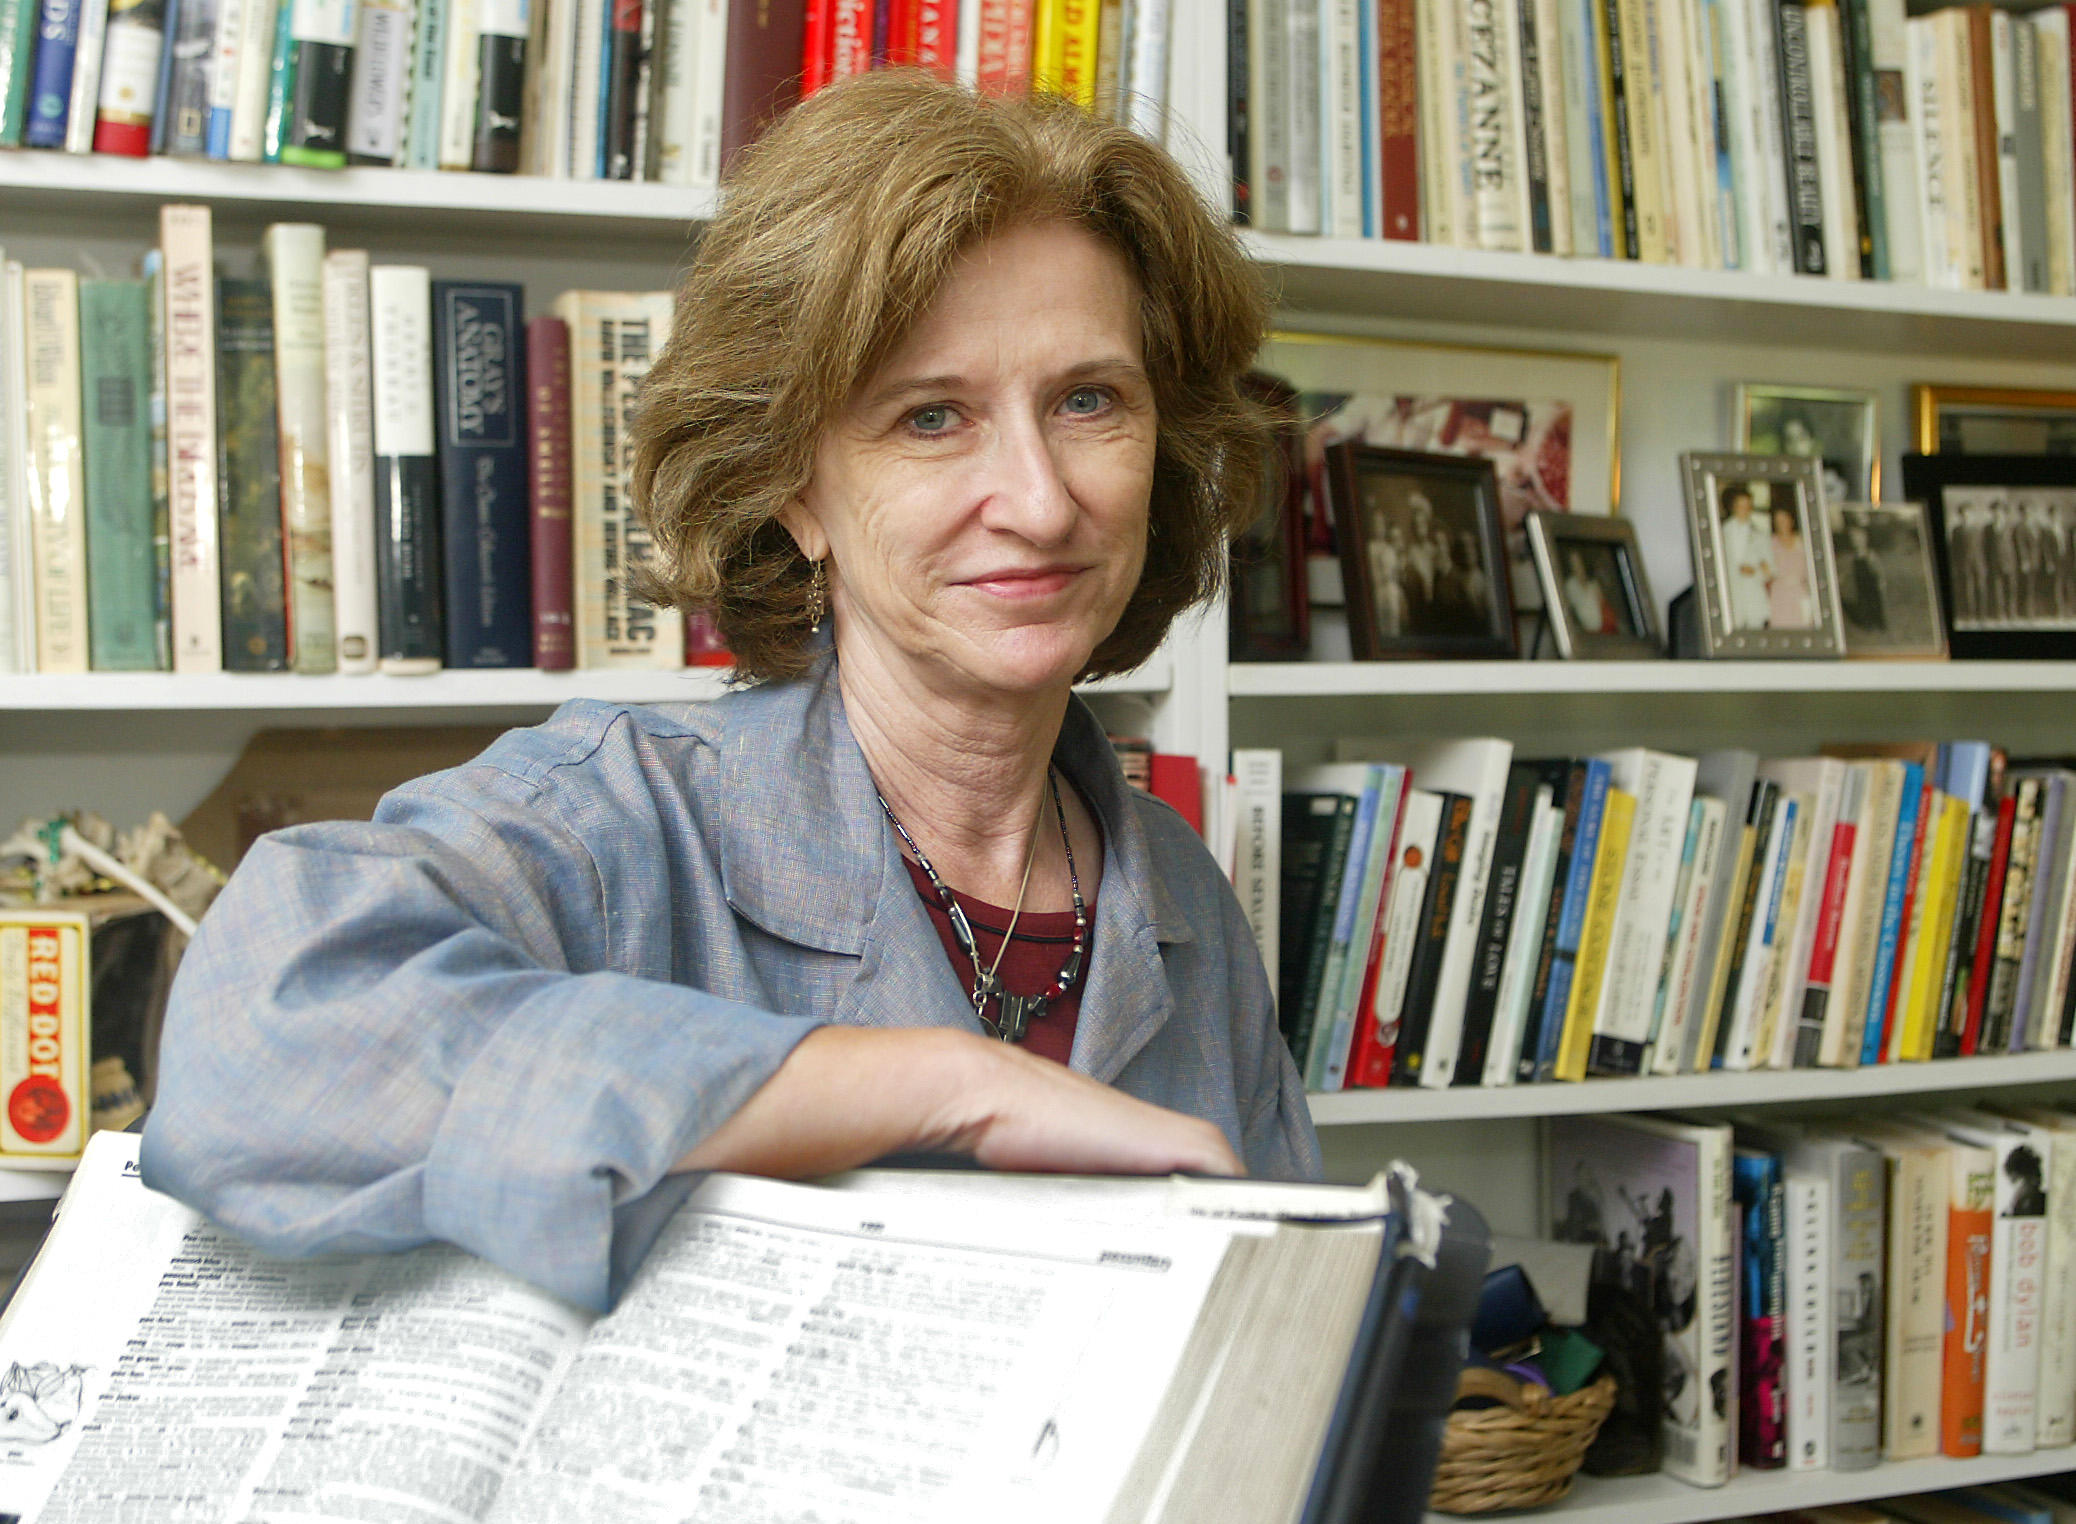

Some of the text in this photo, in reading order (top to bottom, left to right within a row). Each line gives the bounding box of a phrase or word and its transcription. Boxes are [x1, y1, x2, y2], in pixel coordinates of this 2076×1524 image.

[1797, 162, 1823, 229] BEAUTY
[1922, 81, 1945, 215] SILENCE
[173, 262, 204, 362] WHERE
[621, 320, 651, 363] THE
[175, 372, 206, 424] THE
[456, 300, 486, 436] ANATOMY
[481, 322, 508, 417] GRAY'S
[1251, 806, 1269, 960] BEFORE SEXUAL
[1495, 865, 1518, 918] TALES
[31, 936, 59, 1080] RED DOT
[1481, 942, 1505, 991] LOVE
[2012, 1221, 2038, 1349] bob dylan
